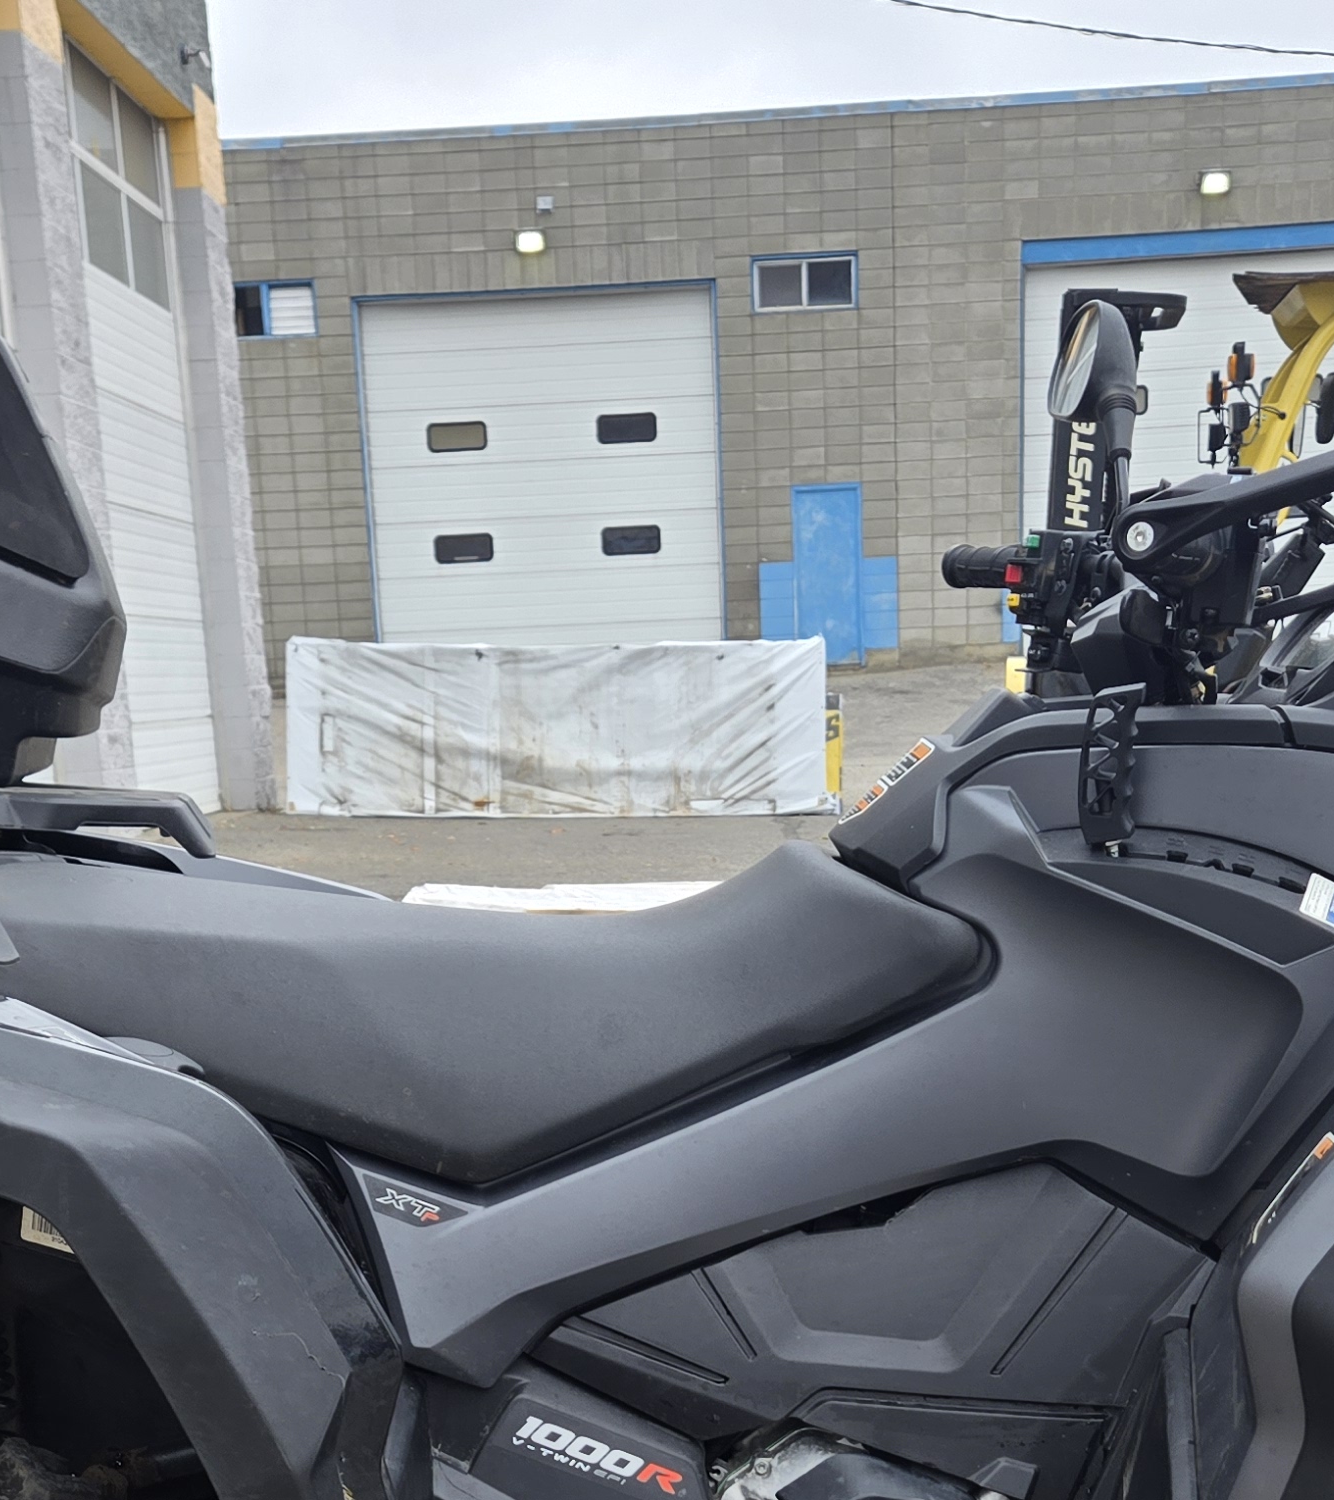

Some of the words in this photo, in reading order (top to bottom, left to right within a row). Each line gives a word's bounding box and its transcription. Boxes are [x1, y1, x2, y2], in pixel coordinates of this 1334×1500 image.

[1064, 421, 1097, 528] HYSTE
[515, 1415, 683, 1495] 1000R
[593, 1468, 627, 1486] EFI
